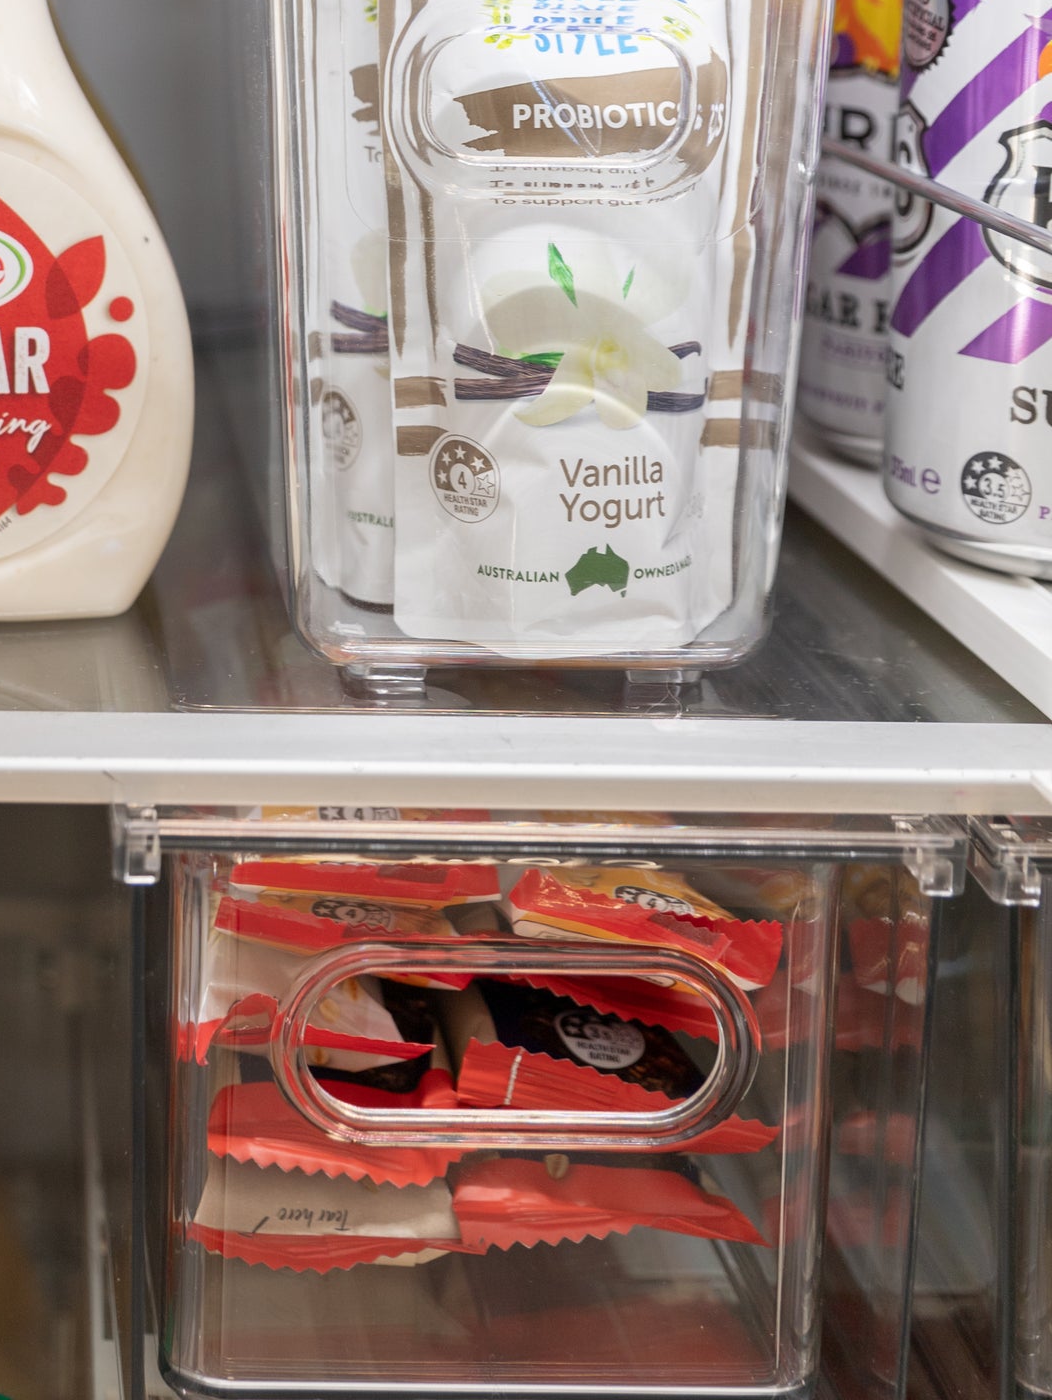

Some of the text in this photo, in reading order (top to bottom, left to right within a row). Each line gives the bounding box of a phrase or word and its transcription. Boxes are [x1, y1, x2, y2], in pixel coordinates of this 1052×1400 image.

[457, 471, 468, 489] 4
[559, 456, 665, 488] Vanilla
[982, 477, 1006, 498] 3.5
[453, 504, 480, 517] RATING
[559, 491, 667, 529] Yogurt
[476, 563, 561, 584] AUSTRALIAN
[633, 562, 676, 579] OWNED
[278, 1207, 350, 1231] Tear here
